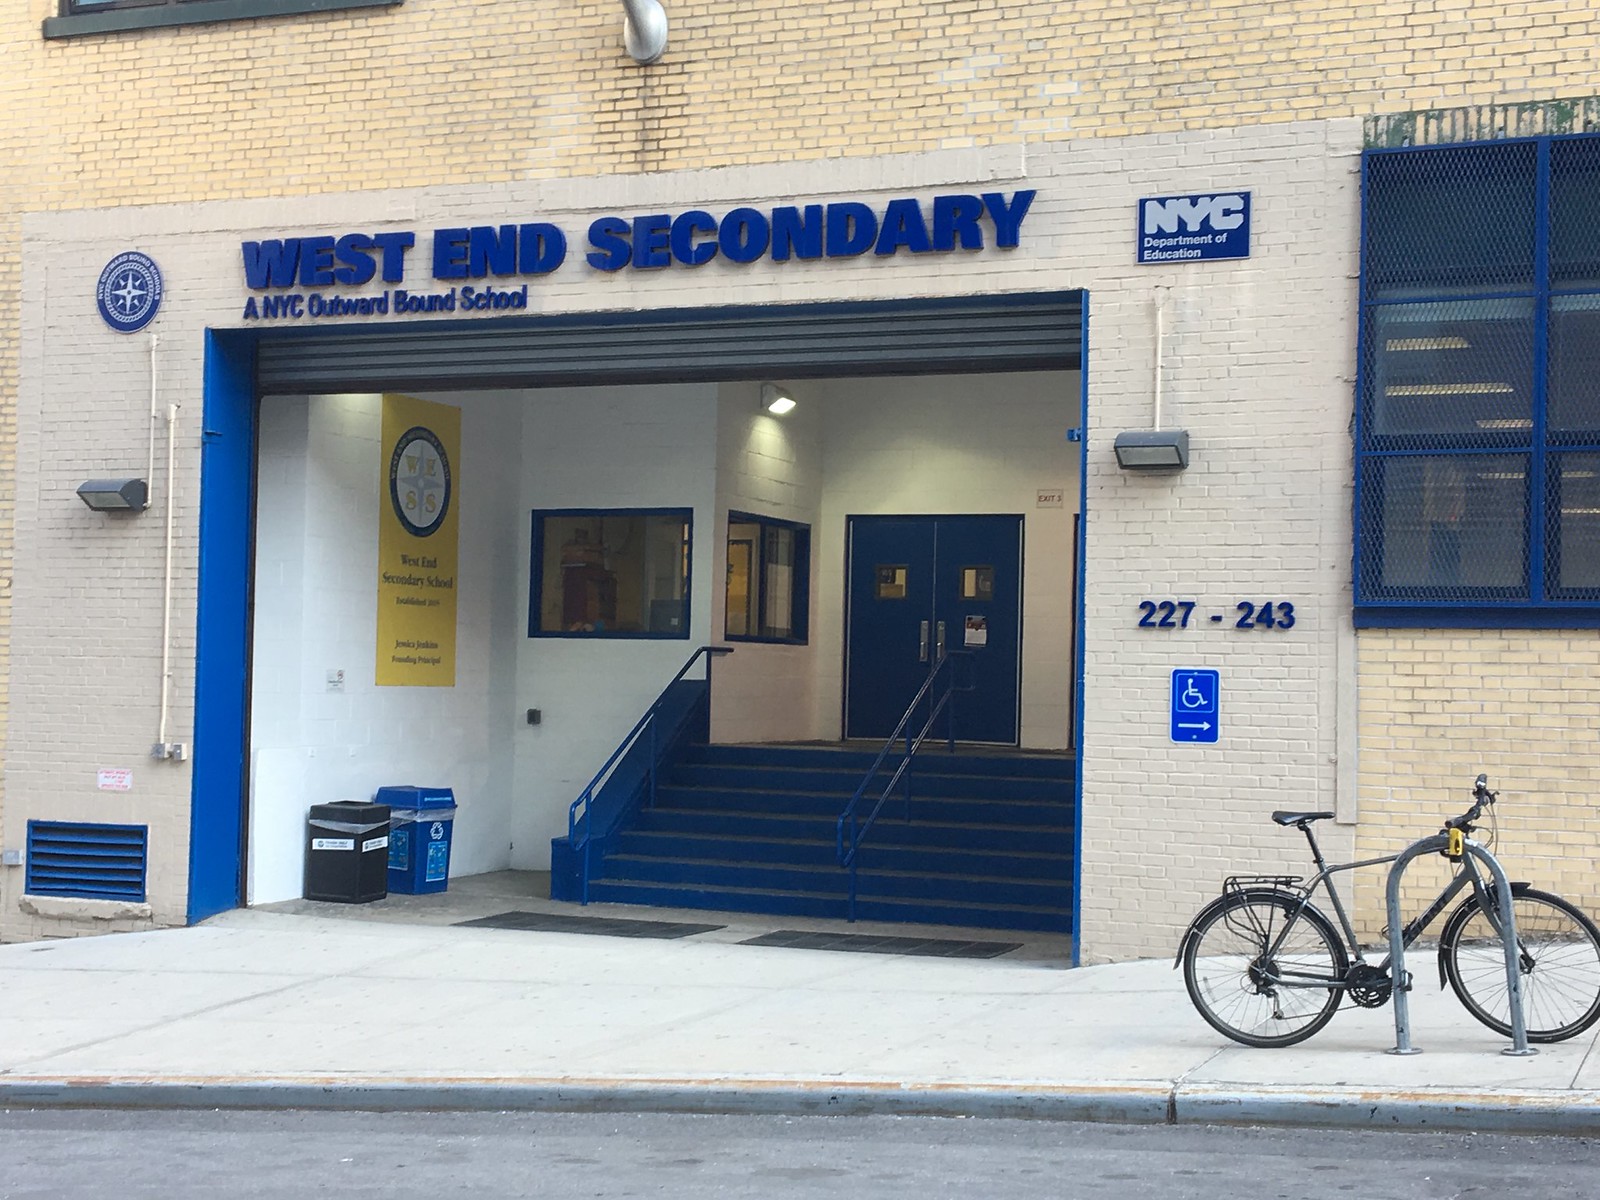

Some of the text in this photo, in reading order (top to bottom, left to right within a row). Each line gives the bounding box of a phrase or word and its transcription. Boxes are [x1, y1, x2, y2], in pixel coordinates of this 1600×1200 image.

[1144, 195, 1244, 234] NYC
[242, 190, 1037, 289] WEST END SECONDARY
[1144, 233, 1228, 248] Department of
[1143, 248, 1201, 260] Education
[129, 254, 151, 267] BOUND
[149, 265, 161, 300] SCHOOLS
[243, 284, 528, 319] A NYC Outward Bound School
[425, 493, 436, 513] S
[1038, 495, 1056, 503] EXIT
[401, 554, 437, 569] West End
[382, 571, 453, 590] Secondary School
[1138, 600, 1196, 628] 227
[1236, 601, 1295, 629] 243
